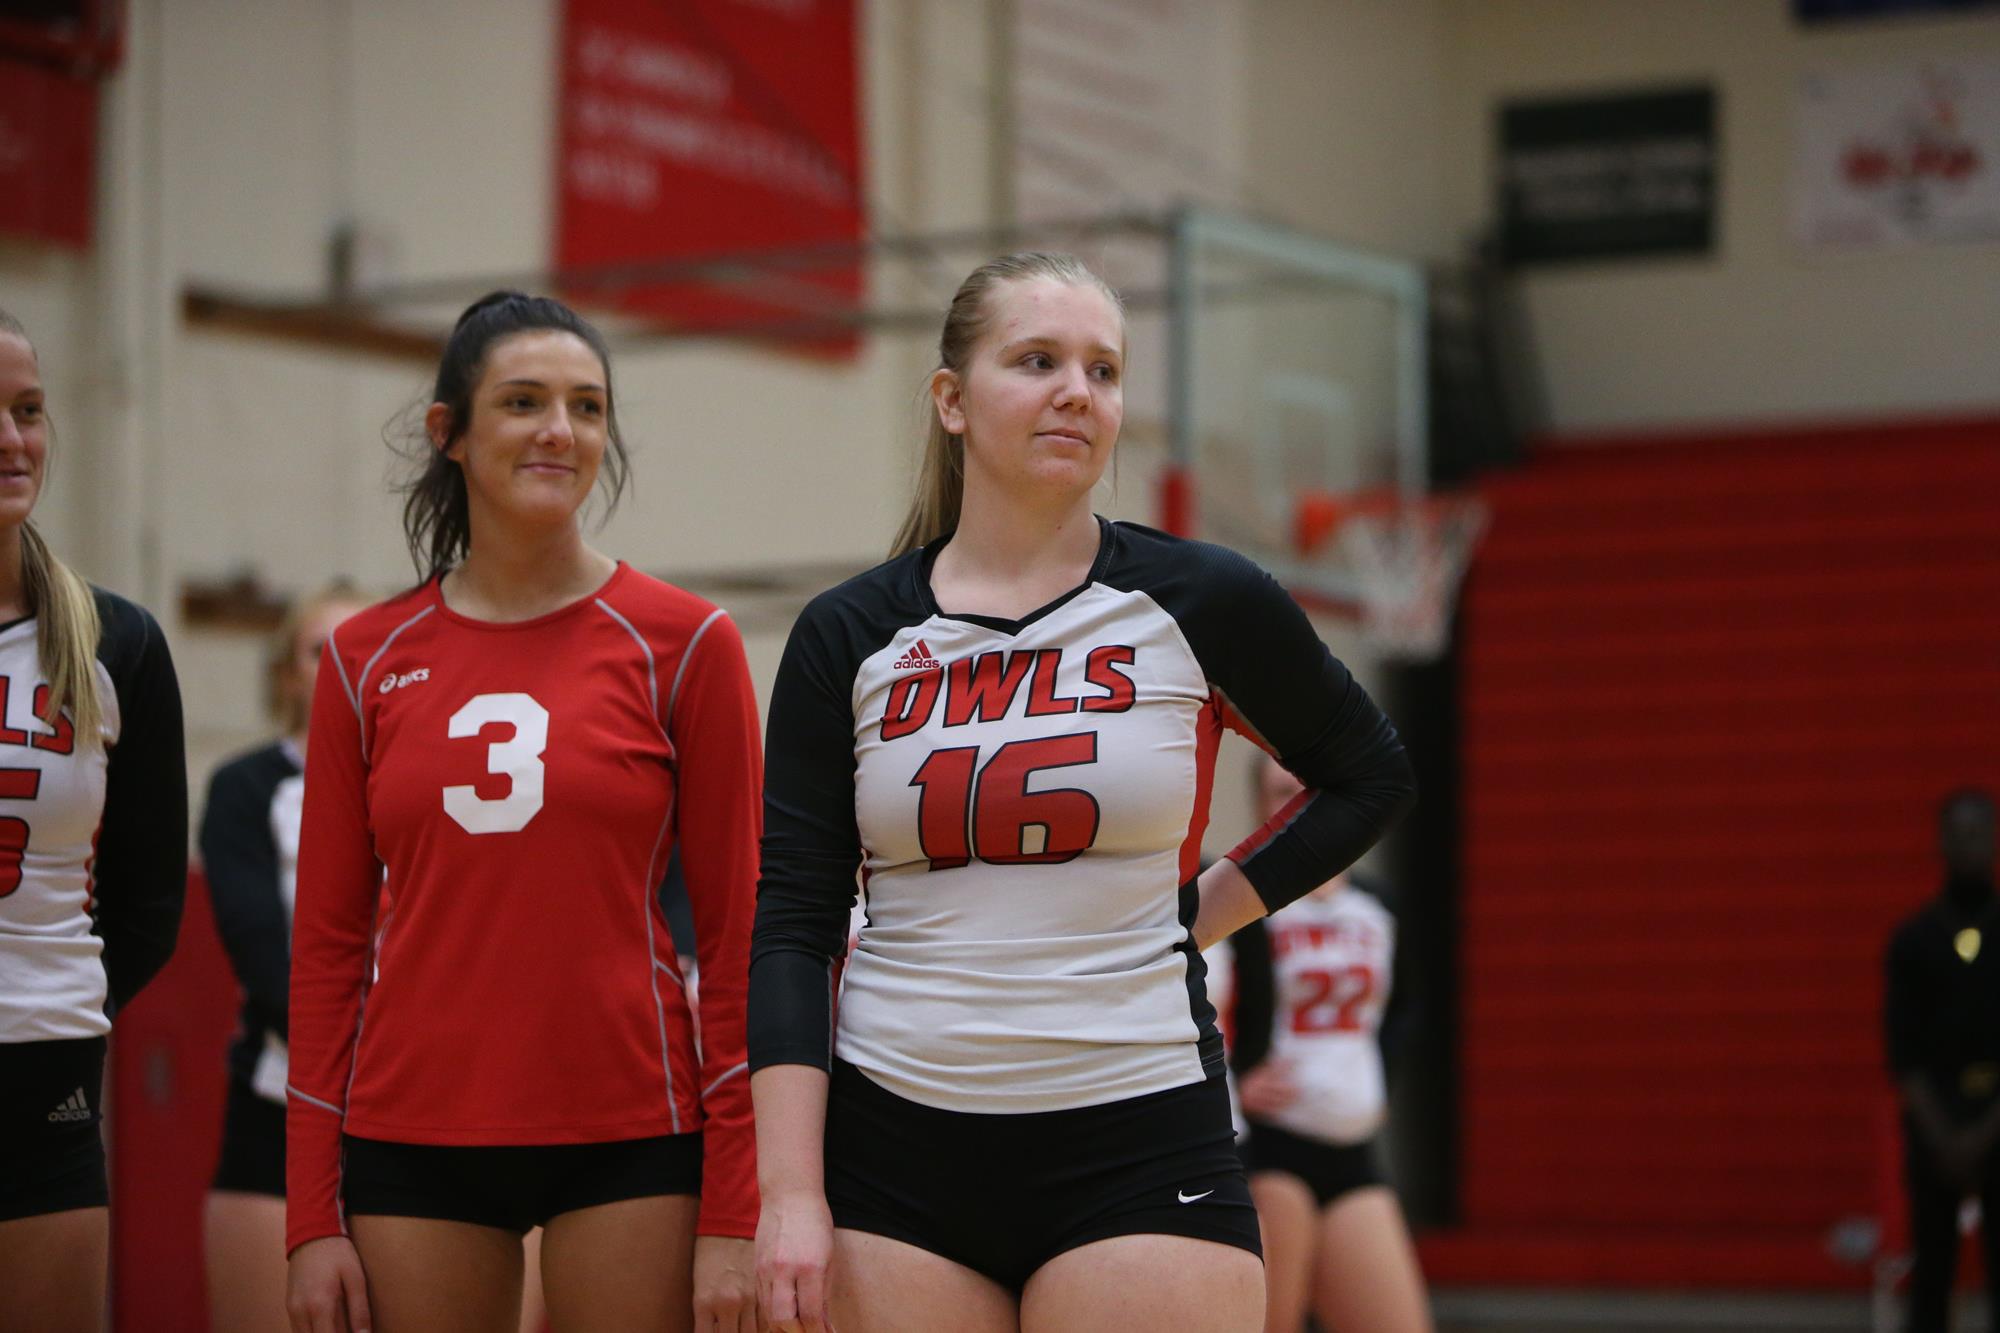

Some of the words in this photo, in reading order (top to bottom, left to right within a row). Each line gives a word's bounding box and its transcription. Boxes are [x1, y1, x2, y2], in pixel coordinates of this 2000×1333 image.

[879, 645, 1137, 742] OWLS
[893, 658, 940, 669] adidas
[442, 692, 550, 835] 3
[908, 731, 1100, 872] 16
[1289, 963, 1376, 1036] 22
